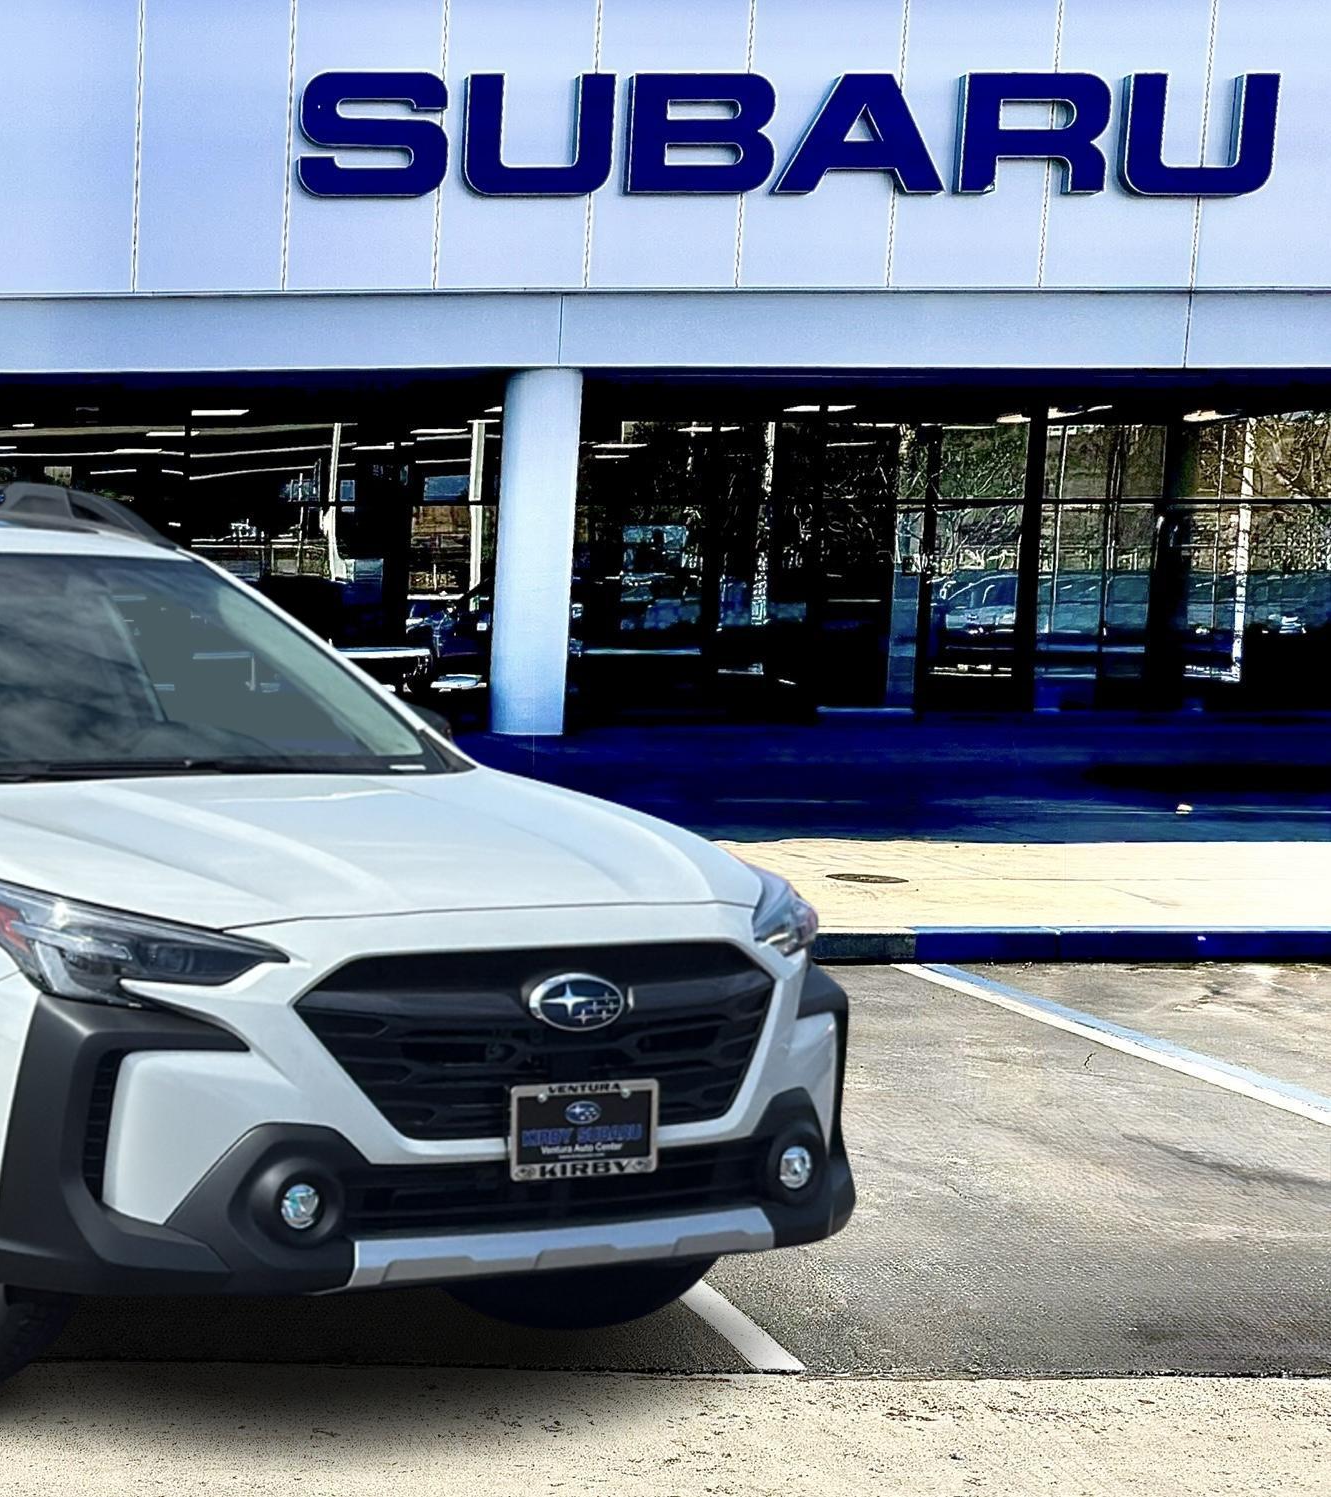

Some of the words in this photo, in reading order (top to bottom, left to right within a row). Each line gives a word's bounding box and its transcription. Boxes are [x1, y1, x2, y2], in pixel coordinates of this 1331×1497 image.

[297, 71, 1281, 198] SUBARU
[547, 1082, 621, 1094] VENTURA
[522, 1128, 574, 1146] KIRBY
[577, 1124, 642, 1143] SUBARU
[541, 1145, 573, 1155] Ventura
[574, 1143, 594, 1153] Auto
[595, 1141, 623, 1151] Center
[539, 1160, 630, 1178] KIRBY
